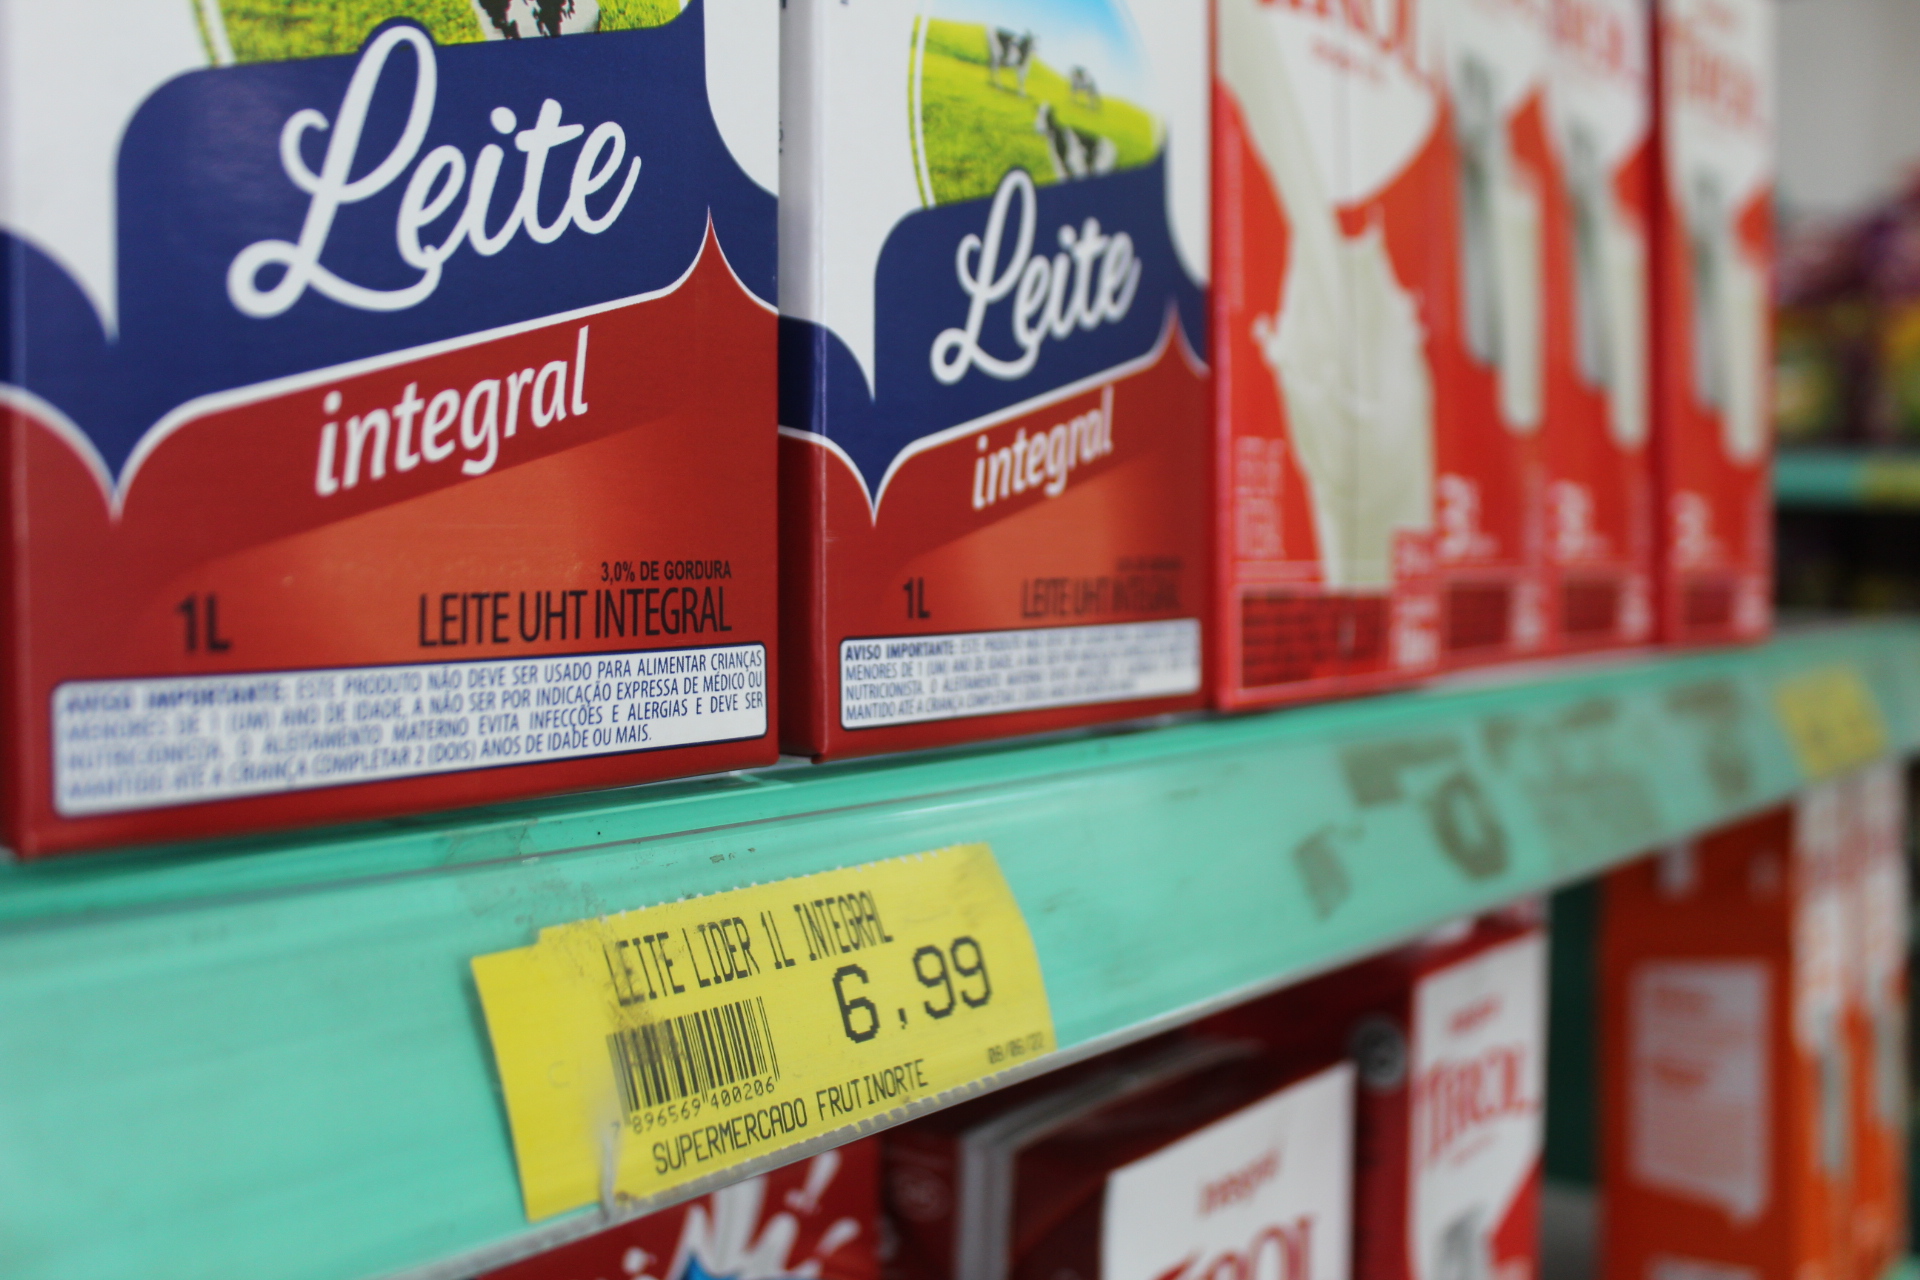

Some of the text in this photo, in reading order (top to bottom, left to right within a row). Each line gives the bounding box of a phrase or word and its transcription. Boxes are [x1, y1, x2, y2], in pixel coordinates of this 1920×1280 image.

[226, 25, 642, 319] Leite
[930, 169, 1142, 385] Leite
[316, 325, 589, 497] integral
[972, 384, 1115, 510] integral
[601, 560, 732, 585] 3,0% DE GORDURA
[903, 577, 931, 619] 1L
[176, 594, 232, 654] 1L
[419, 586, 732, 647] LEITE UHT INTEGRAL
[428, 665, 462, 690] NÃO
[468, 666, 506, 689] DEVE
[512, 665, 538, 687] SER
[544, 661, 592, 683] USADO
[598, 660, 632, 679] PARA
[638, 654, 706, 677] ALIMENTAR
[711, 650, 762, 672] CRIANÇAS
[845, 644, 881, 661] AVISO
[846, 662, 898, 681] MENORES
[902, 661, 914, 678] DE
[392, 717, 469, 741] MATERNO
[478, 713, 519, 735] EVITA
[529, 704, 603, 732] INFECÇÕES
[612, 705, 619, 723] E
[627, 698, 688, 721] ALERGIAS
[696, 697, 702, 715] E
[710, 694, 739, 714] DEVE
[745, 691, 763, 710] SER
[429, 689, 464, 714] NÃO
[469, 691, 496, 713] SER
[501, 688, 531, 710] POR
[536, 680, 612, 707] INDICAÇÃO
[617, 678, 678, 700] EXPRESSA
[684, 677, 698, 695] DE
[703, 671, 745, 693] MÉDICO
[749, 671, 763, 689] OU
[846, 701, 896, 721] MANTIDO
[428, 740, 477, 763] (DOIS)
[480, 735, 521, 757] ANOS
[526, 734, 543, 755] DE
[547, 729, 589, 751] IDADE
[593, 727, 612, 746] OU
[616, 724, 652, 744] MAIS.
[603, 890, 893, 1007] LEITE LIDER 1L INTEGRAL
[633, 1097, 702, 1135] 896569
[710, 1076, 776, 1110] 400206
[652, 1058, 929, 1175] SUPERMERCADO FRUTINORTE
